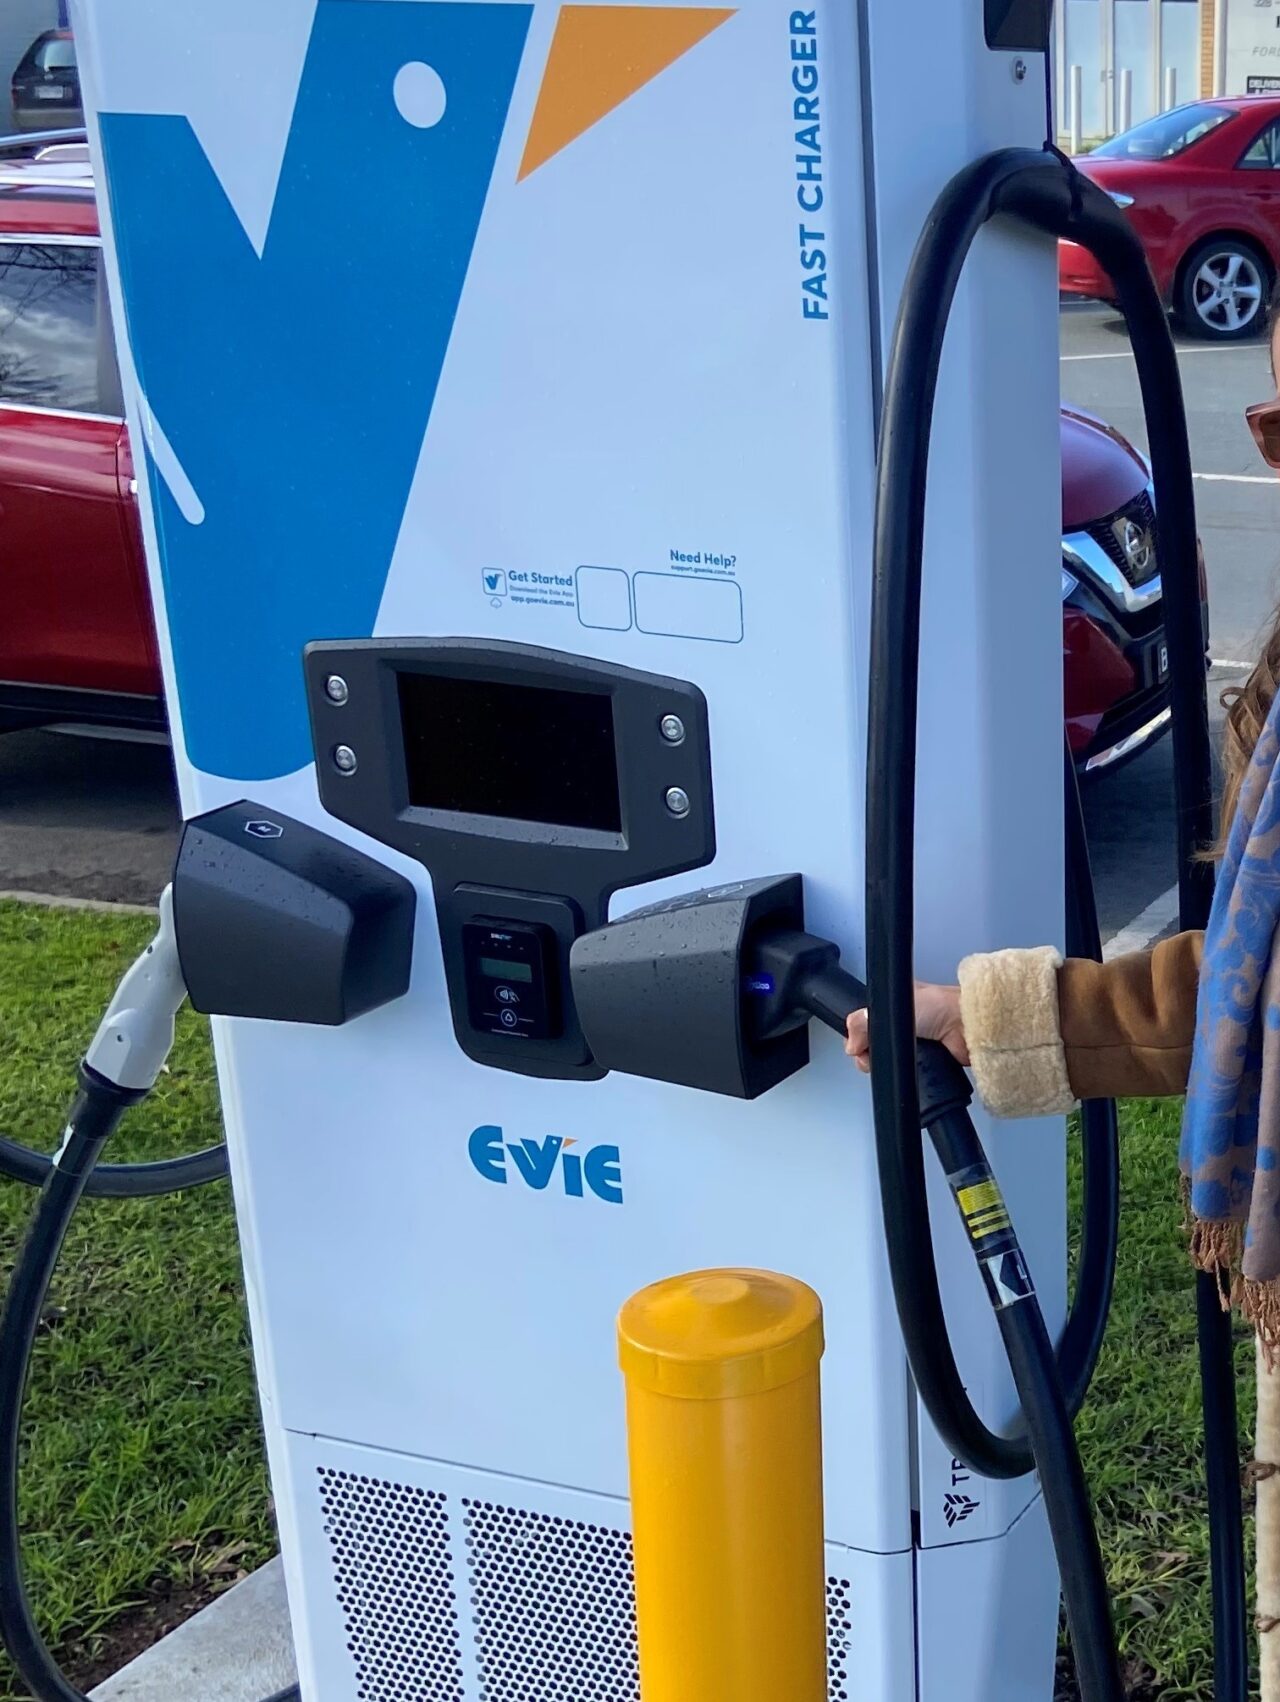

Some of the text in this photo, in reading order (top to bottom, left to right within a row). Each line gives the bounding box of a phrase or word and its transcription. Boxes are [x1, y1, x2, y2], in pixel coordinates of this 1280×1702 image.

[789, 10, 829, 320] FAST CHARGER
[670, 549, 737, 569] Need Help?
[508, 570, 573, 587] Get Started
